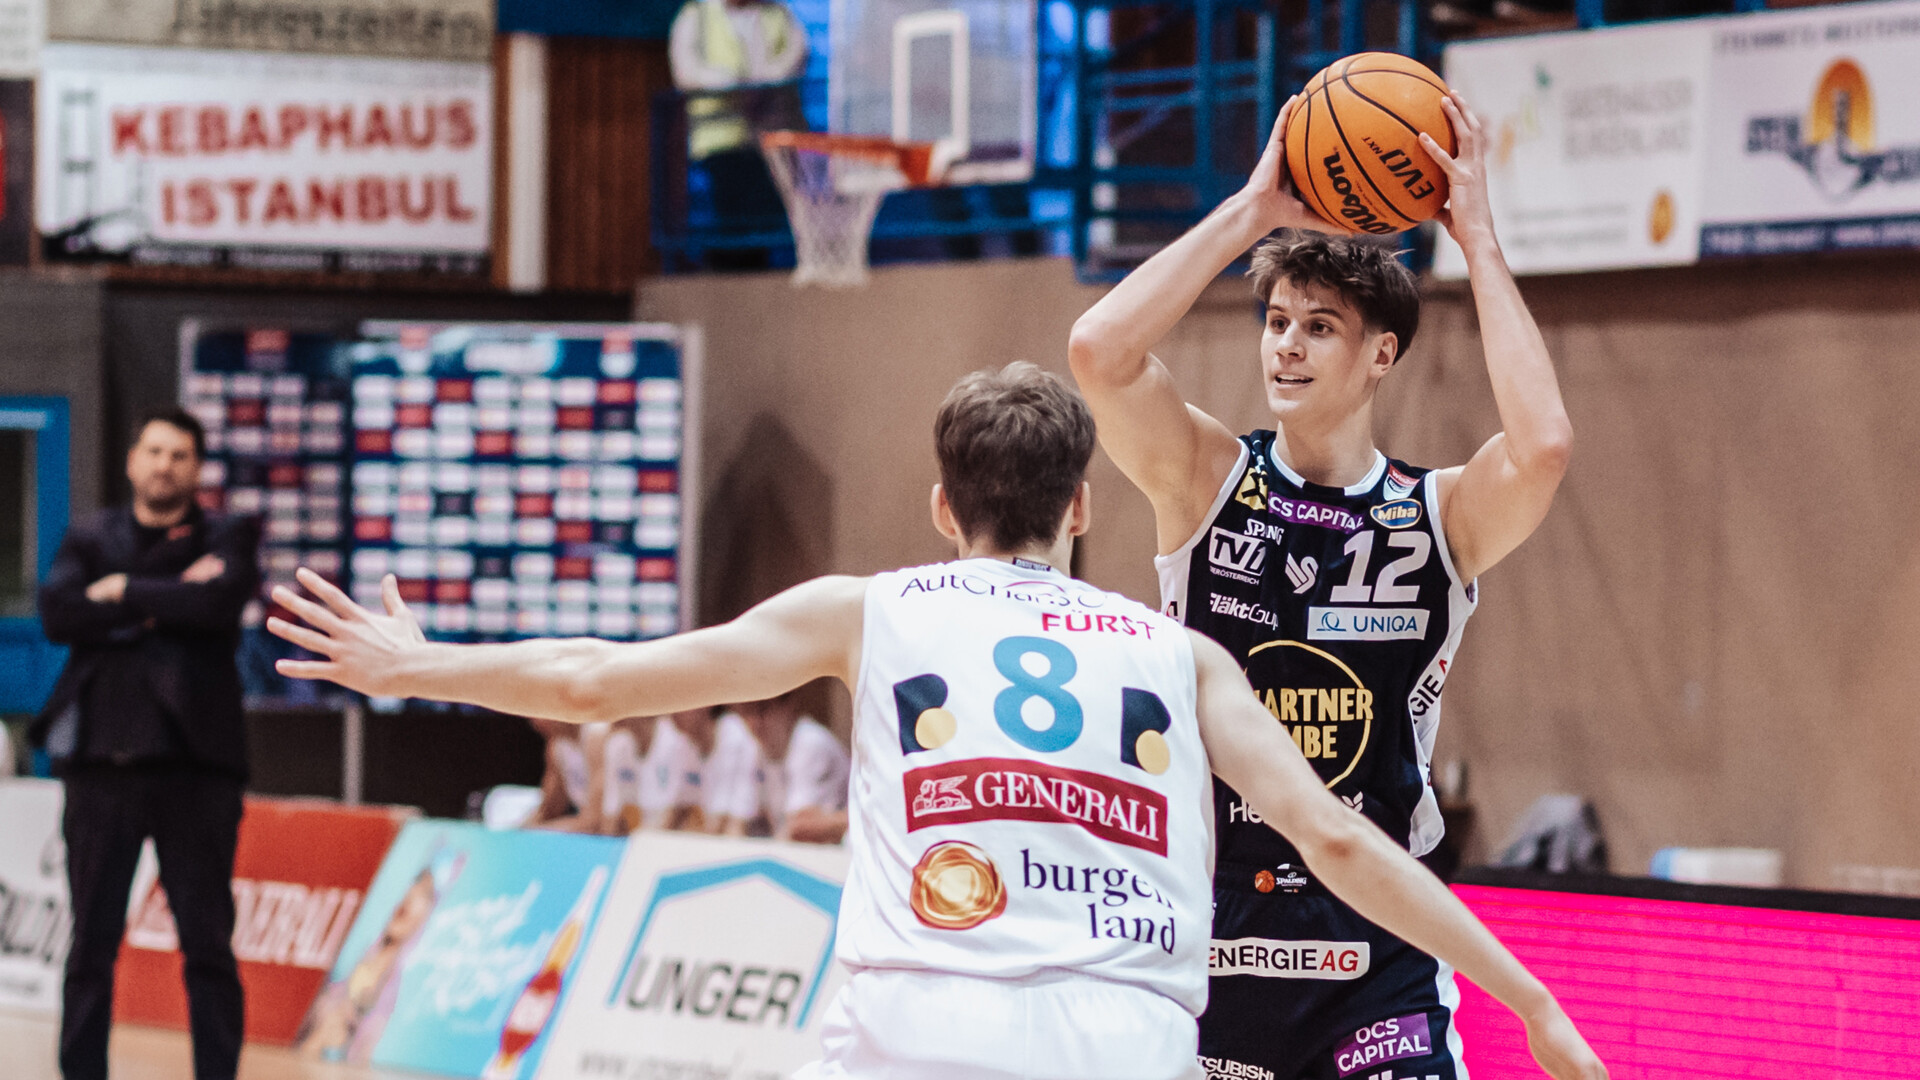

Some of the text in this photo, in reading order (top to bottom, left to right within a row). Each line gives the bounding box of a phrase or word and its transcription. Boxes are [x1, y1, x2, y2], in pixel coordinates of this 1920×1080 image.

[111, 101, 477, 157] KEBAPHAUS
[161, 174, 475, 226] ISTANBUL
[1269, 496, 1364, 530] CS CAPITAL
[1377, 505, 1418, 521] Miba
[1329, 530, 1432, 602] 12
[1042, 610, 1155, 641] FÜRST
[1353, 615, 1418, 633] UNIQA
[993, 635, 1084, 753] 8
[1254, 687, 1374, 722] ARTNER
[974, 771, 1159, 842] GENERALI
[1087, 903, 1175, 955] land
[626, 955, 802, 1026] UNGER
[1355, 1018, 1400, 1044] OCS
[1197, 1054, 1275, 1080] TSUBISHI
[1338, 1034, 1429, 1072] CAPITAL
